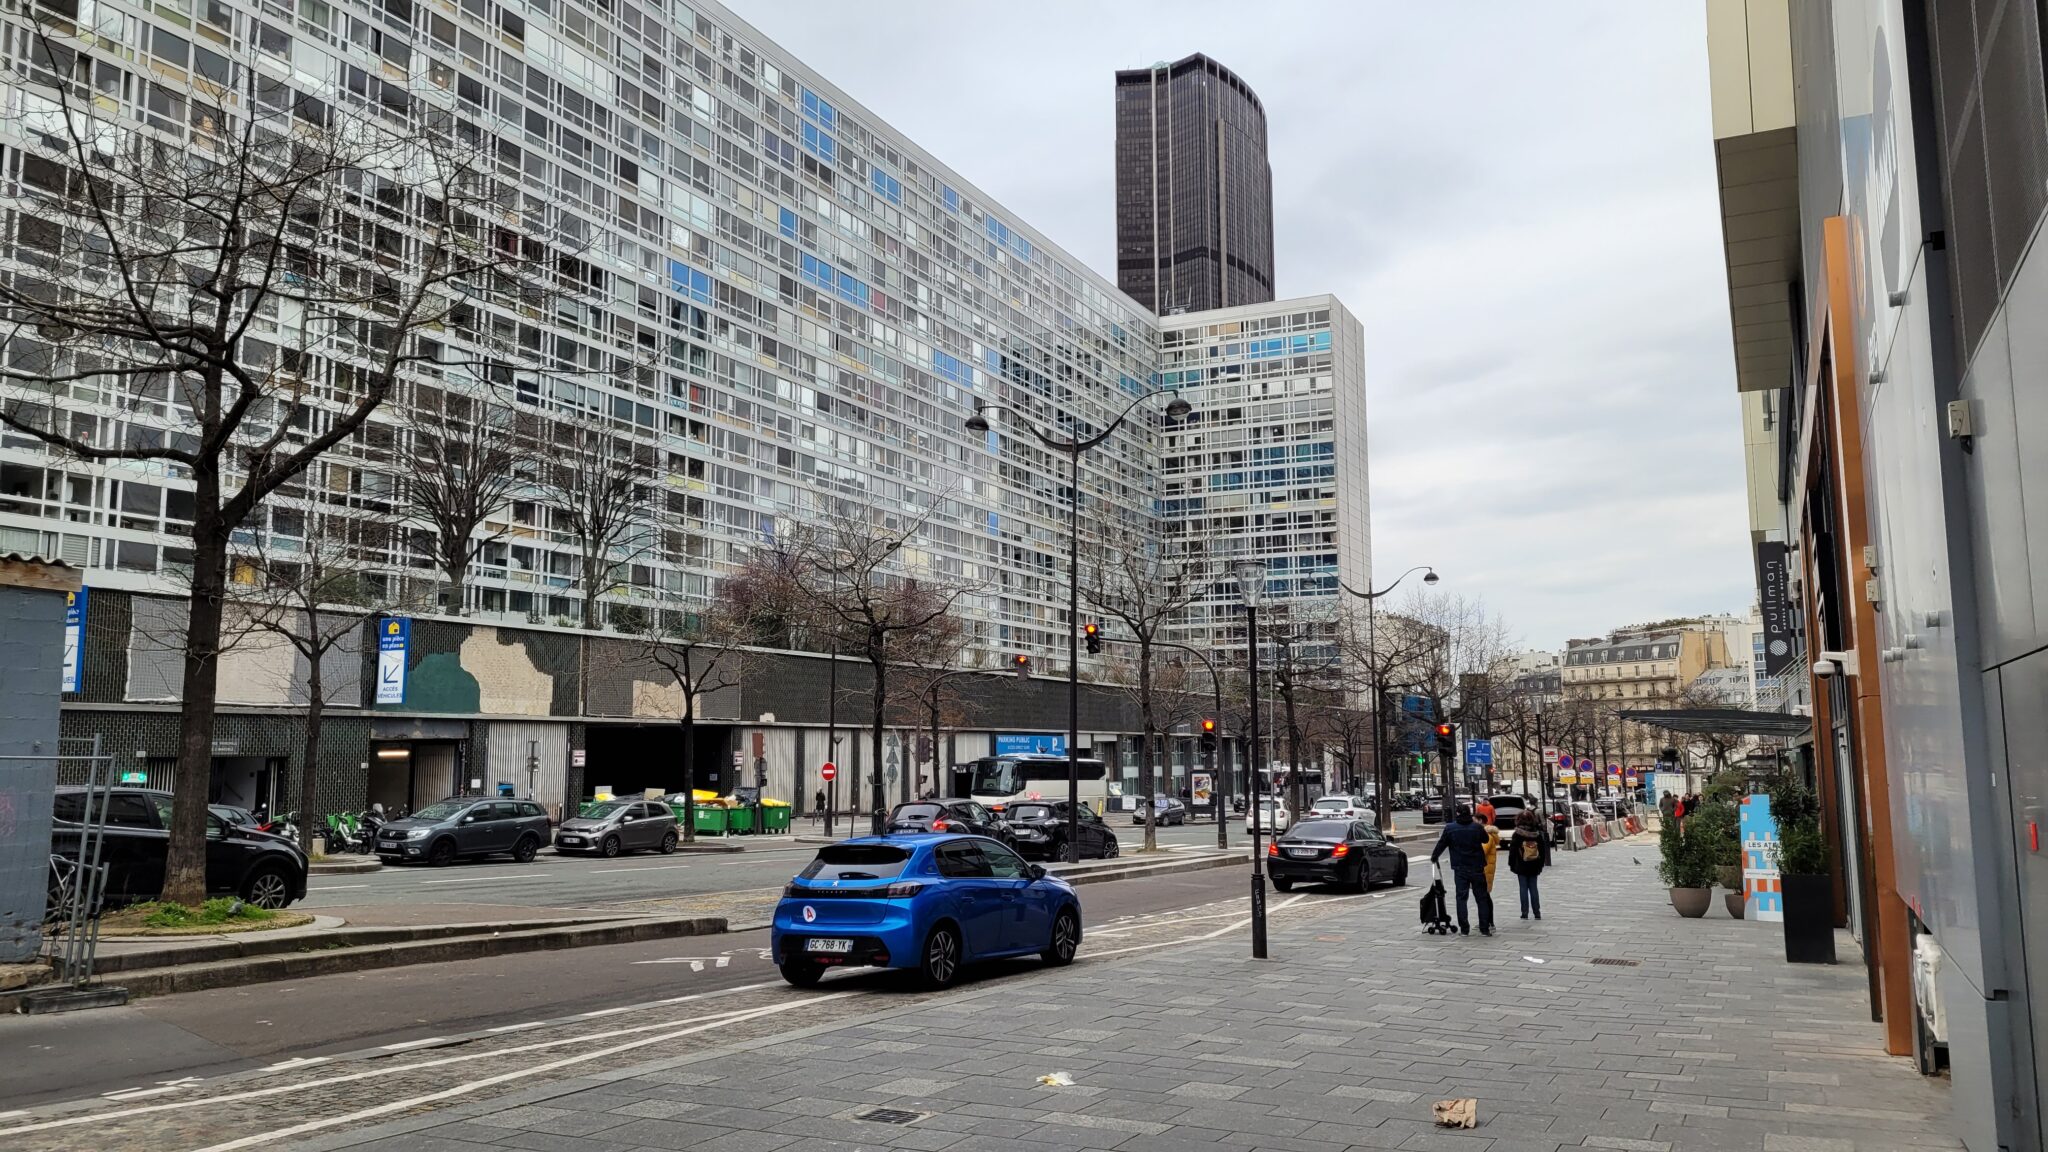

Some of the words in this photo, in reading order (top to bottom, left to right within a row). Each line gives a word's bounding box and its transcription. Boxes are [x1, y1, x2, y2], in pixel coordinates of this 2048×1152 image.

[1766, 561, 1782, 633] pullman
[807, 908, 814, 920] A
[810, 940, 847, 950] GC-768-YK
